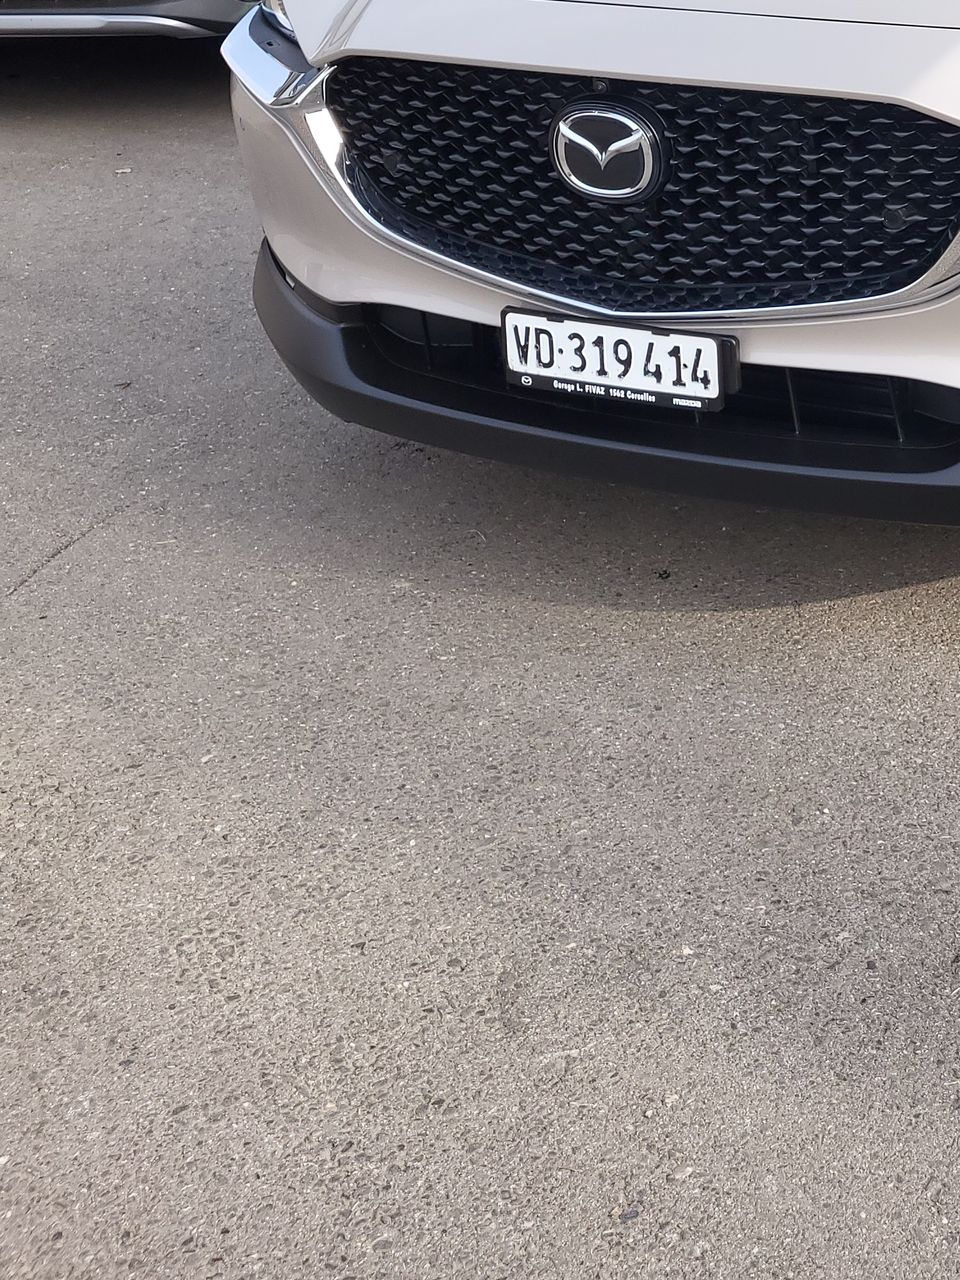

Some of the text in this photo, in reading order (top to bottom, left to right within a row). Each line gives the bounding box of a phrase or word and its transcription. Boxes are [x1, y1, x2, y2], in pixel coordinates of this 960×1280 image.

[553, 380, 575, 392] Garage
[585, 384, 606, 395] FIVAZ
[609, 387, 625, 398] 1562
